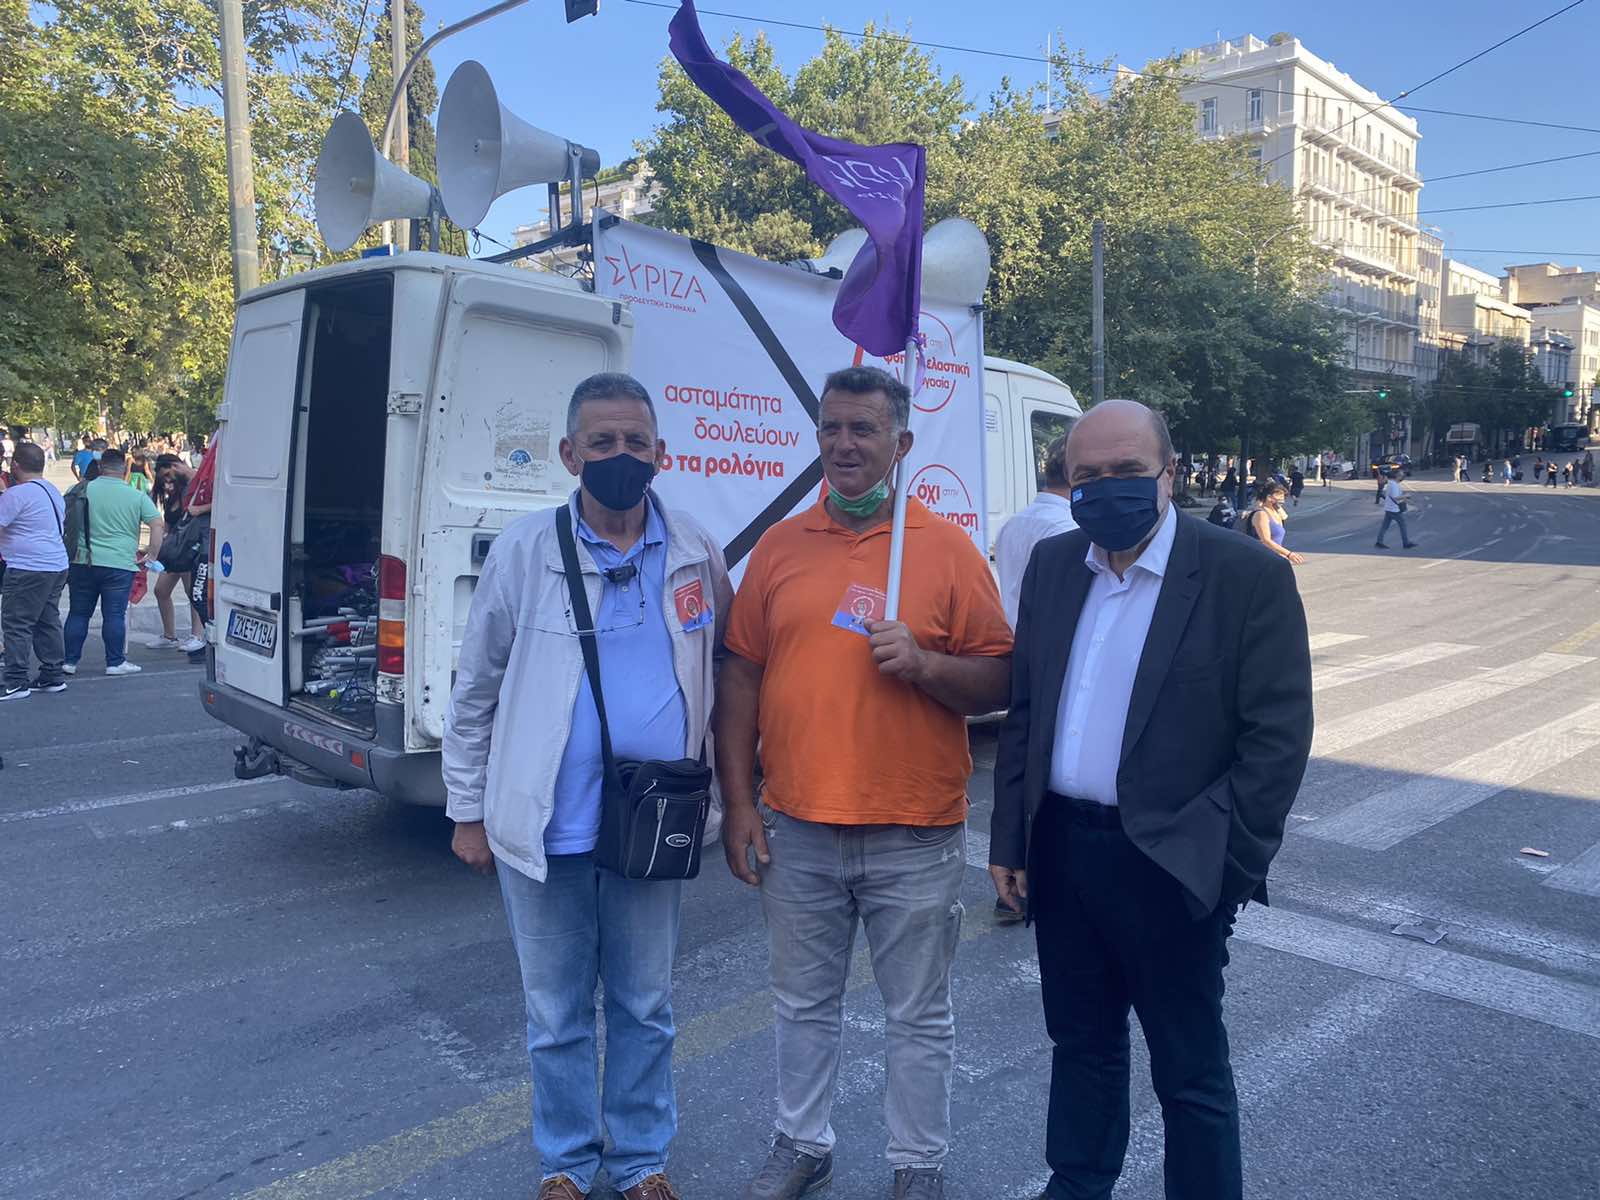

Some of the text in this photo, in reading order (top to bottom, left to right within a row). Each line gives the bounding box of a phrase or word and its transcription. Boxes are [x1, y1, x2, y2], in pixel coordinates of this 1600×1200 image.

[926, 355, 971, 379] ελαστική
[664, 384, 783, 417] ασταμάτητα
[694, 416, 800, 448] δουλεύουν
[676, 454, 702, 473] τα
[704, 452, 785, 481] ρολόγια
[916, 477, 941, 505] όχι
